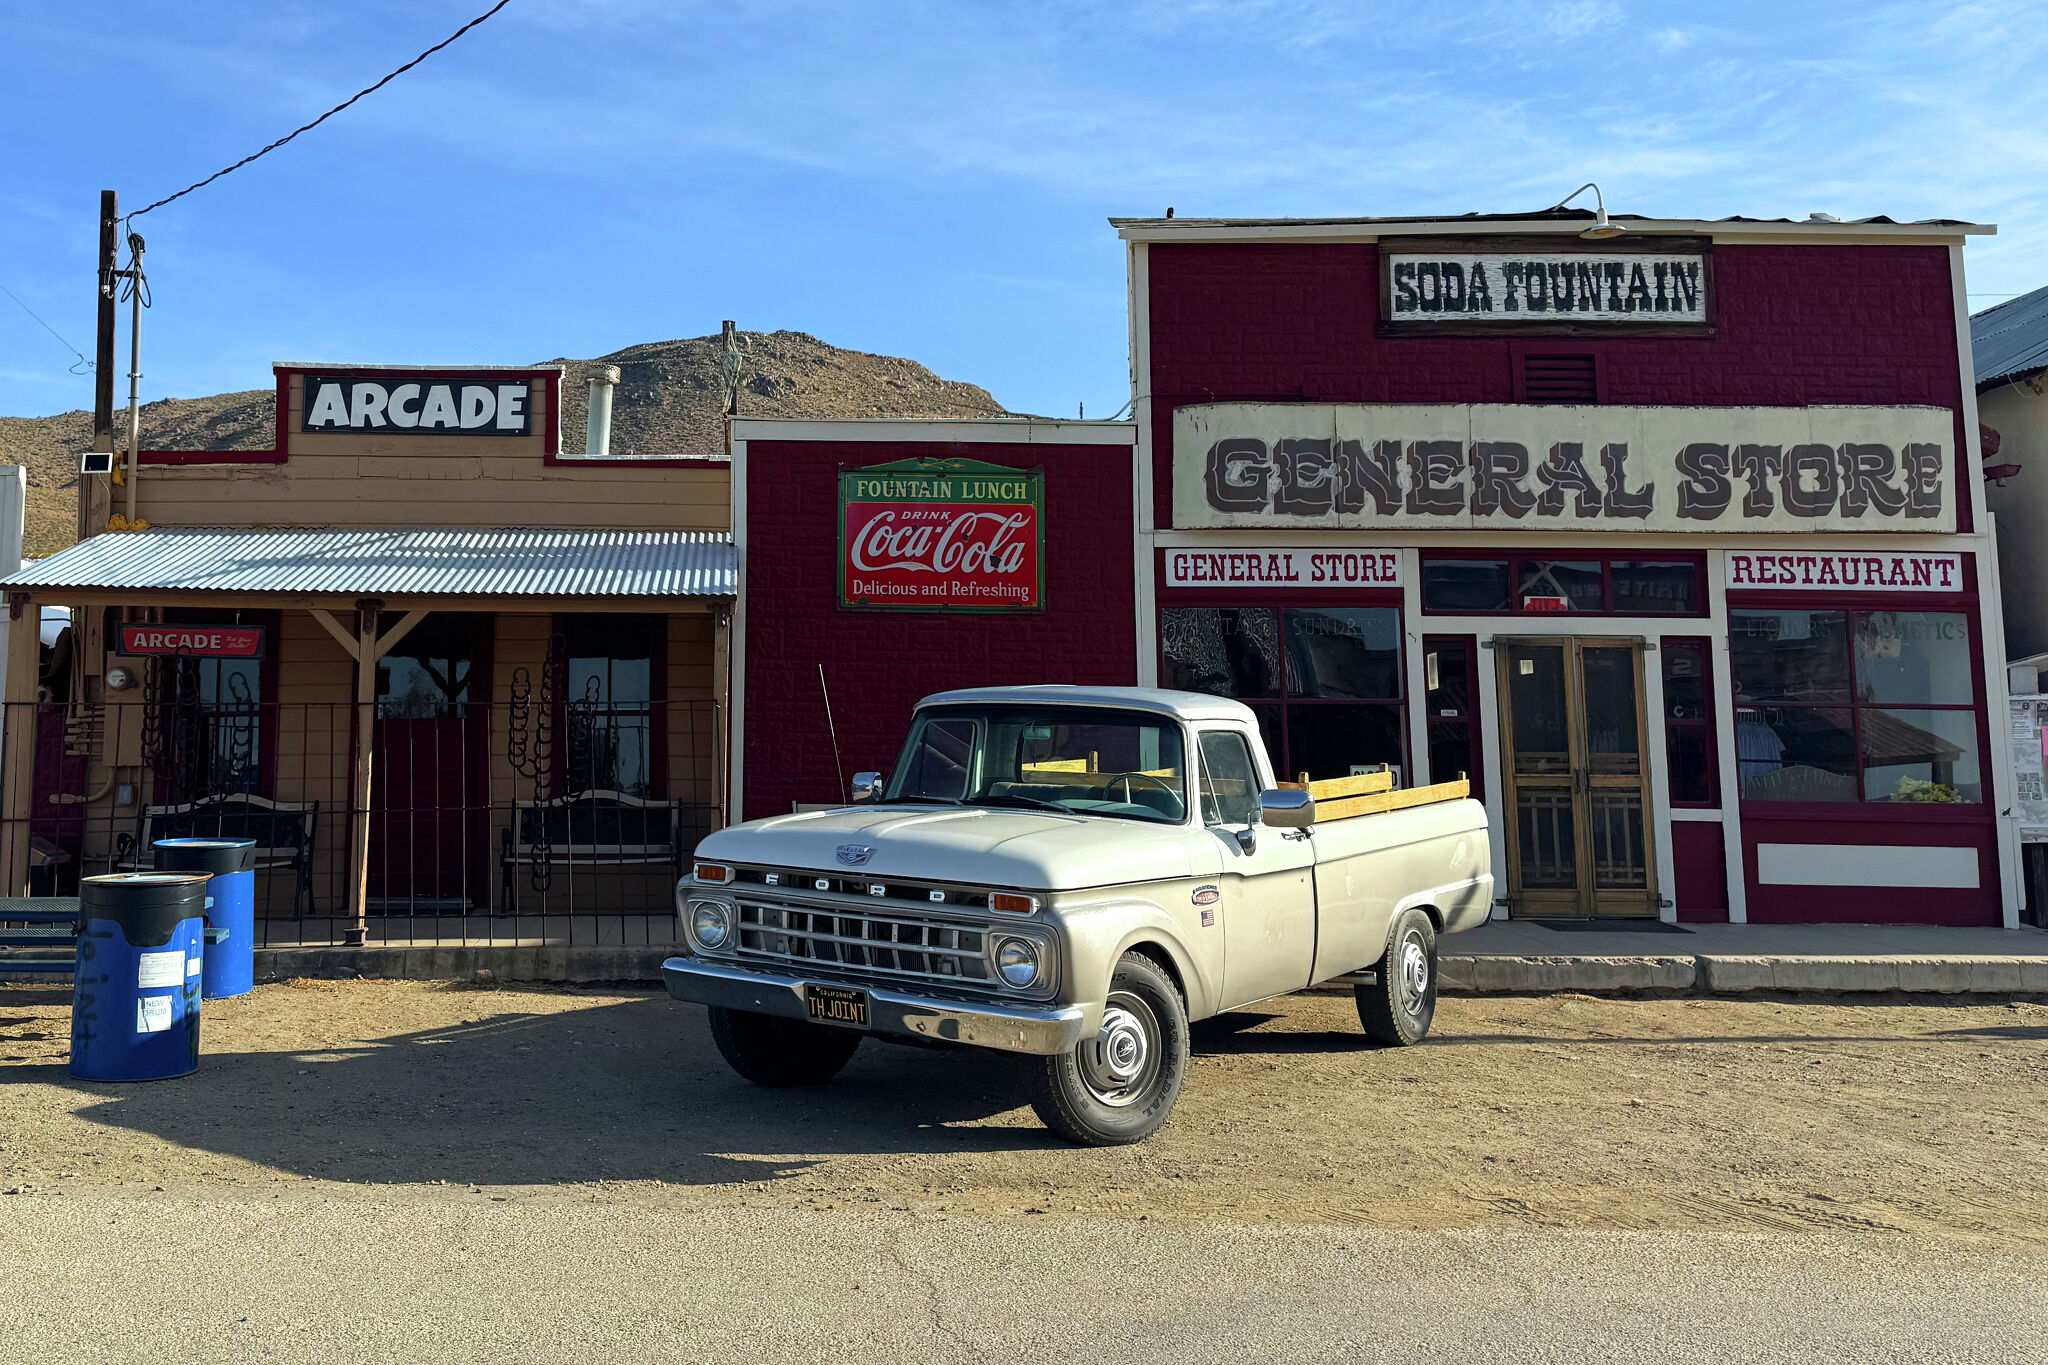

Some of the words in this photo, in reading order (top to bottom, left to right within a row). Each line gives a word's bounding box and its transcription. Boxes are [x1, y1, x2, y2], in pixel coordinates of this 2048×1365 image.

[1394, 261, 1493, 313] SODA
[1502, 261, 1700, 312] FOUNTAIN
[309, 382, 528, 429] ARCADE
[856, 480, 952, 498] FOUNTAIN
[962, 482, 1027, 500] LUNCH
[1203, 437, 1655, 519] GENERAL
[1674, 441, 1944, 521] STORE
[901, 511, 952, 520] DRINK
[850, 511, 1032, 574] Coca-Cola
[1173, 553, 1300, 582] GENERAL
[1310, 553, 1397, 582] STORE
[1731, 555, 1955, 587] RESTAURANT
[852, 579, 918, 595] Delicious
[921, 581, 947, 596] and
[951, 580, 1030, 602] Refreshing
[133, 632, 222, 649] ARCADE
[765, 872, 946, 903] FORD
[819, 989, 853, 999] CALIFORNIA
[827, 999, 865, 1022] JOINT
